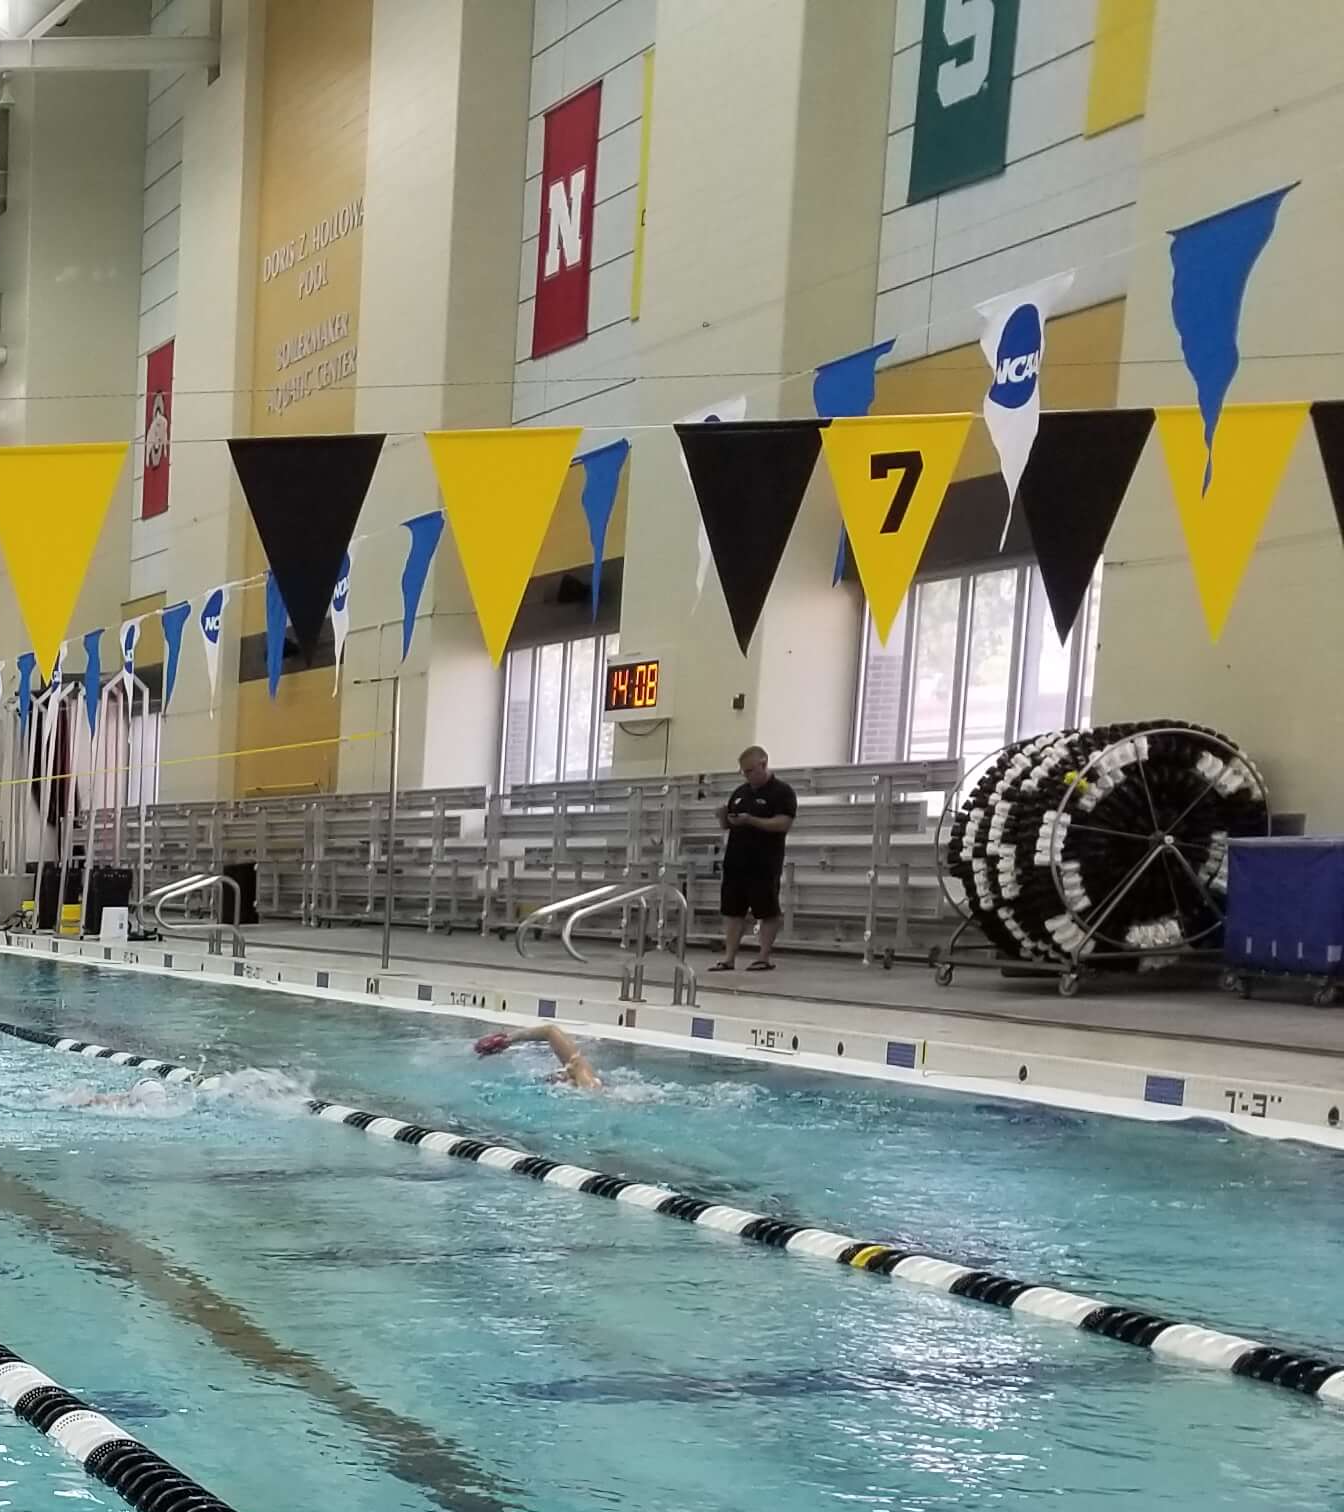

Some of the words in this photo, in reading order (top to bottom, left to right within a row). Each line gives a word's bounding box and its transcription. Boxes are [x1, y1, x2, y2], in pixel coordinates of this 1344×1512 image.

[937, 0, 994, 108] S
[264, 240, 295, 282] DORIS
[312, 198, 365, 252] HOLLOWA
[544, 165, 586, 280] N
[298, 258, 328, 301] POOL
[318, 347, 358, 391] CENTER
[869, 450, 924, 534] 7
[612, 664, 658, 706] 14:08
